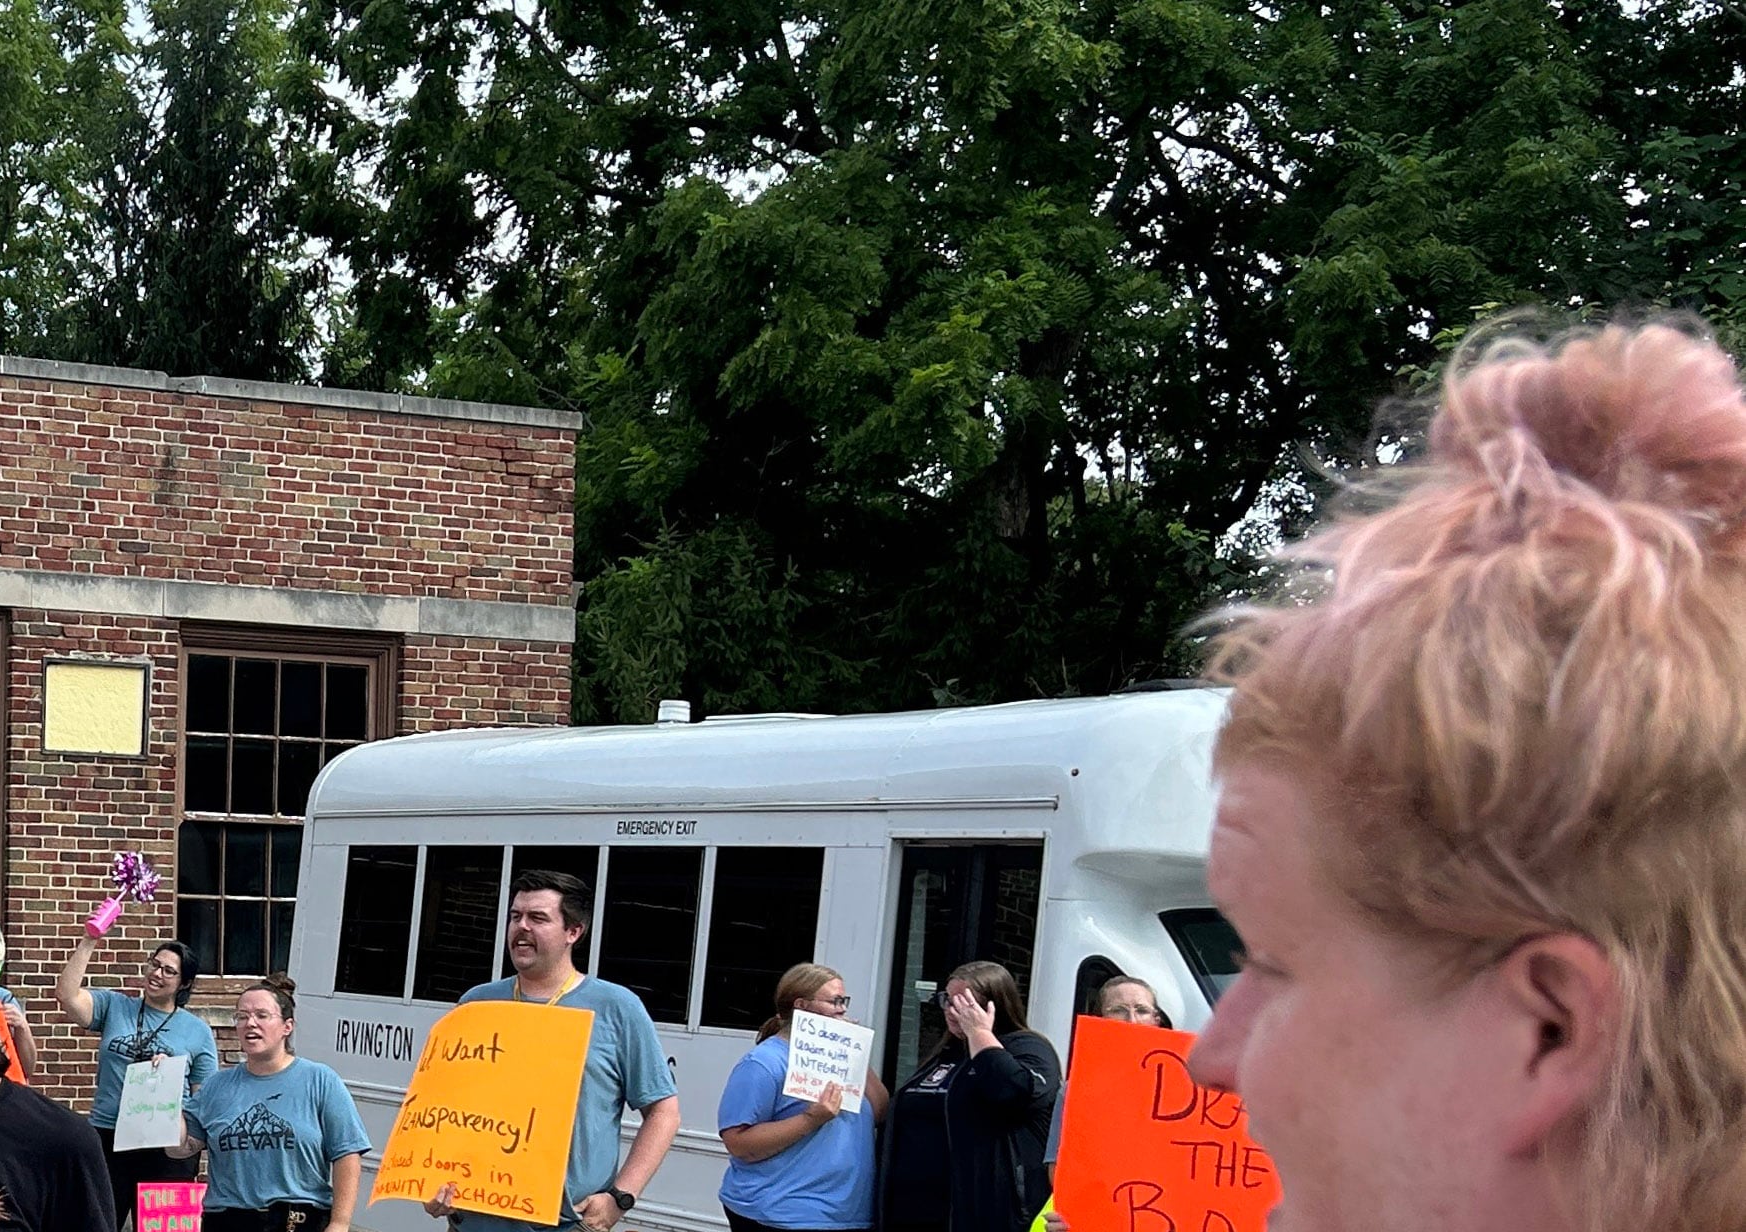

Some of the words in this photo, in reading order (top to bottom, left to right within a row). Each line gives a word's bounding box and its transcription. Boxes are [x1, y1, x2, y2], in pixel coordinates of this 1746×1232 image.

[616, 820, 675, 835] EMERGENCY
[675, 820, 698, 835] EXIT
[796, 1015, 815, 1036] ICS
[336, 1018, 414, 1062] IRVINGTON
[795, 1054, 849, 1081] INTEGRITY
[219, 1132, 296, 1152] ELEVATE
[422, 1148, 472, 1178] doors
[490, 1164, 514, 1186] in
[1170, 1140, 1270, 1188] THE
